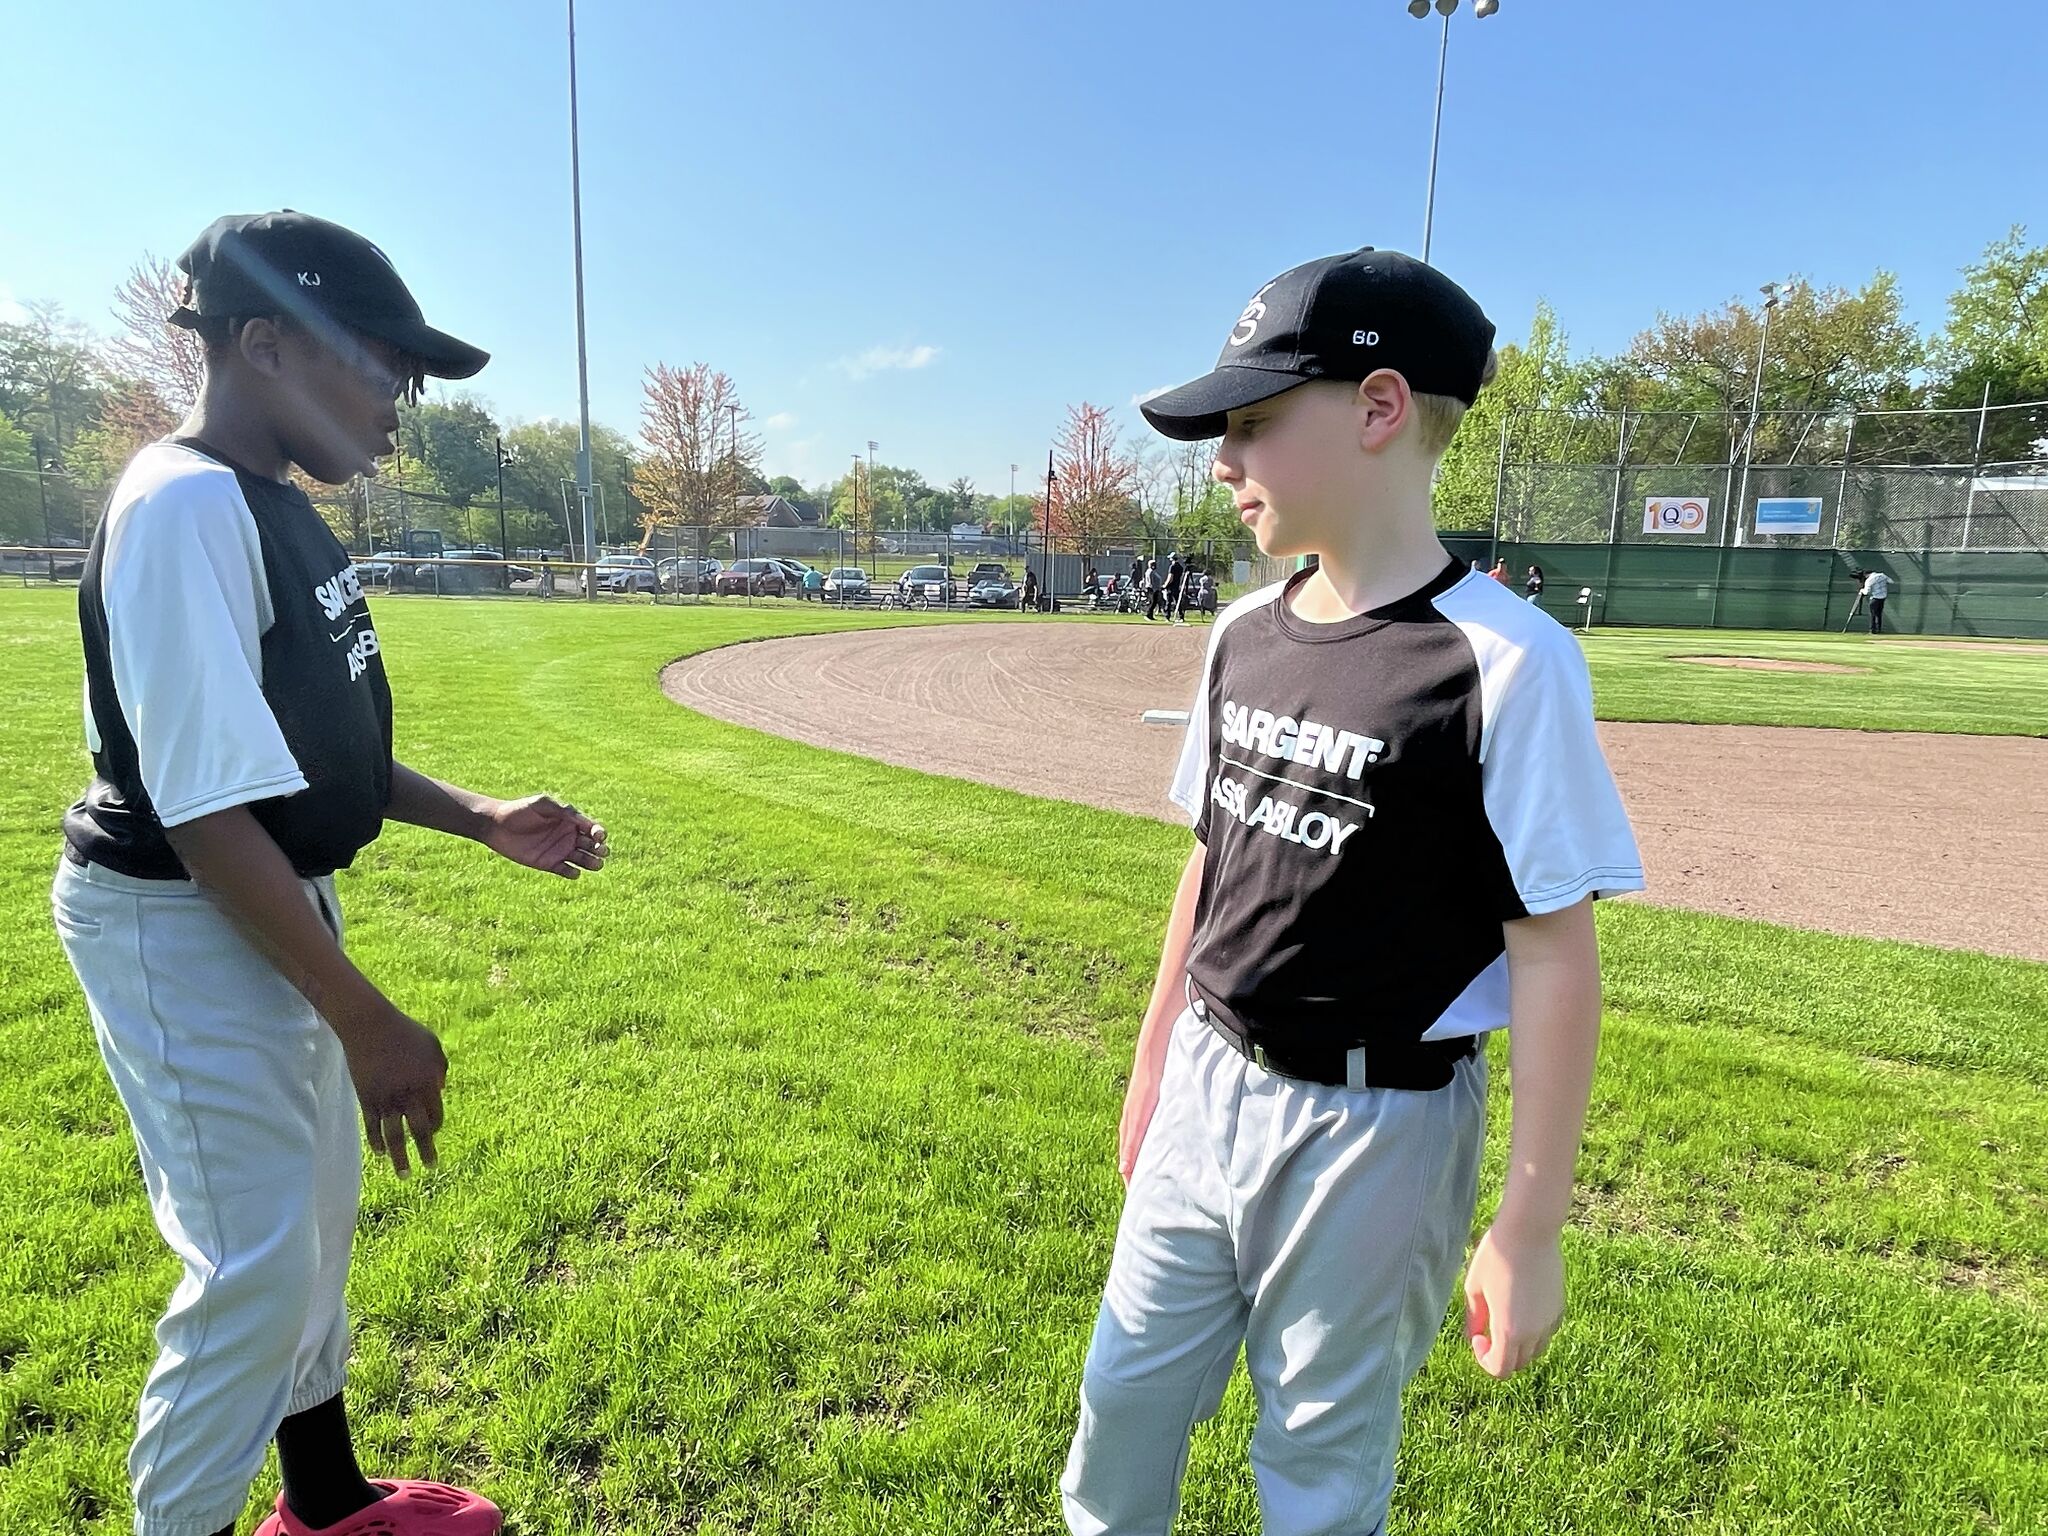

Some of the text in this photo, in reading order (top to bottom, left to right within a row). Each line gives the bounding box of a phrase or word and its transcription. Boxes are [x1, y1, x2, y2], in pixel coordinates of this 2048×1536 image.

[297, 272, 321, 286] KJ
[1221, 700, 1384, 780] SARGENT
[1246, 796, 1359, 855] ABLOY
